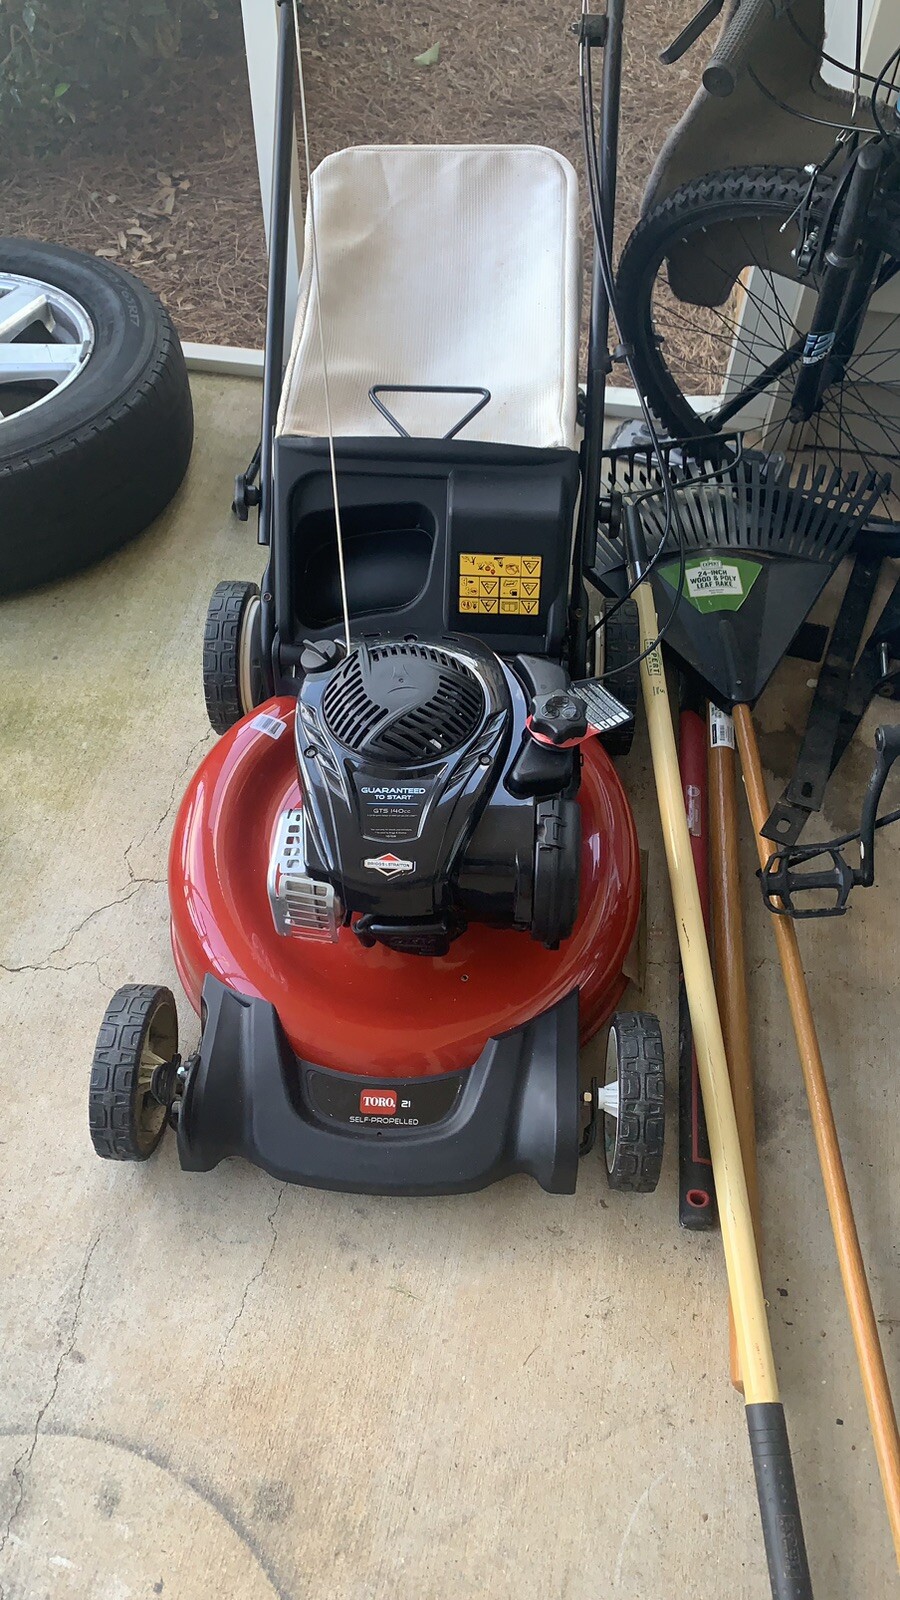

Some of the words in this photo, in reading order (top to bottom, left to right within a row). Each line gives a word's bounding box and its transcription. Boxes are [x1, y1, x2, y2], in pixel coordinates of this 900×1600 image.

[697, 569, 728, 577] 24-INCH
[690, 576, 712, 584] WOOD
[696, 581, 713, 589] LEAF
[649, 641, 660, 674] EPERT
[401, 1100, 411, 1108] 21
[349, 1116, 419, 1126] SELF-PROPELLED
